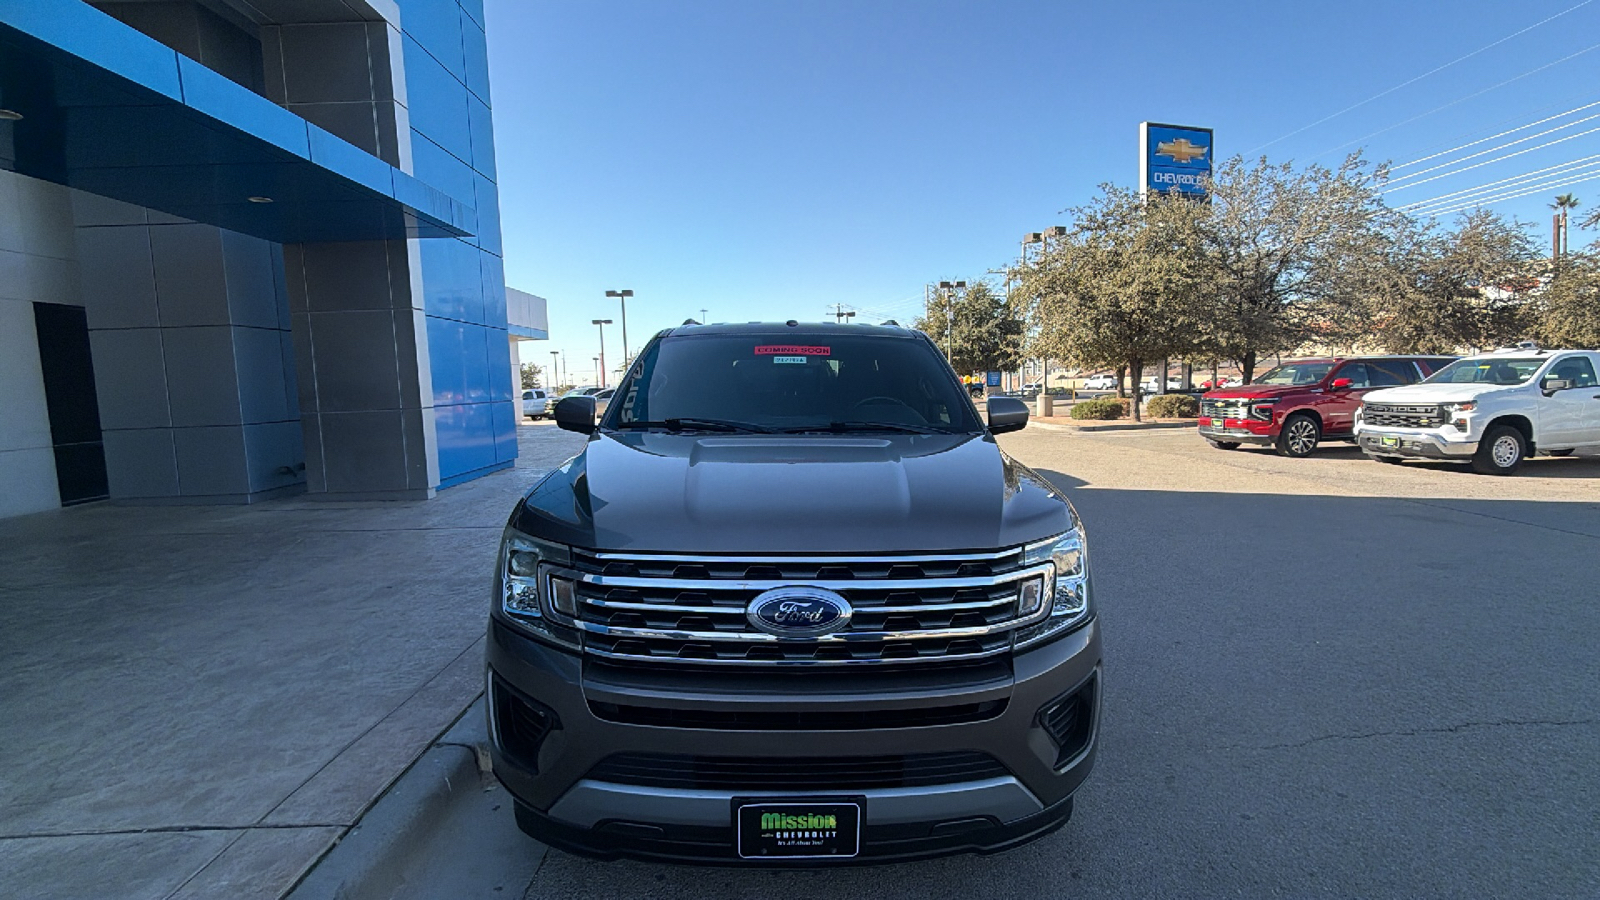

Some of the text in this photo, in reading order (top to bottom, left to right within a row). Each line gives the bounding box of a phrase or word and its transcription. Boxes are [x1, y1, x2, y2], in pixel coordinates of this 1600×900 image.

[1154, 172, 1205, 185] CHEVROLE
[774, 601, 824, 622] Ford
[761, 812, 837, 830] Mission
[776, 831, 837, 839] CHEVROLET
